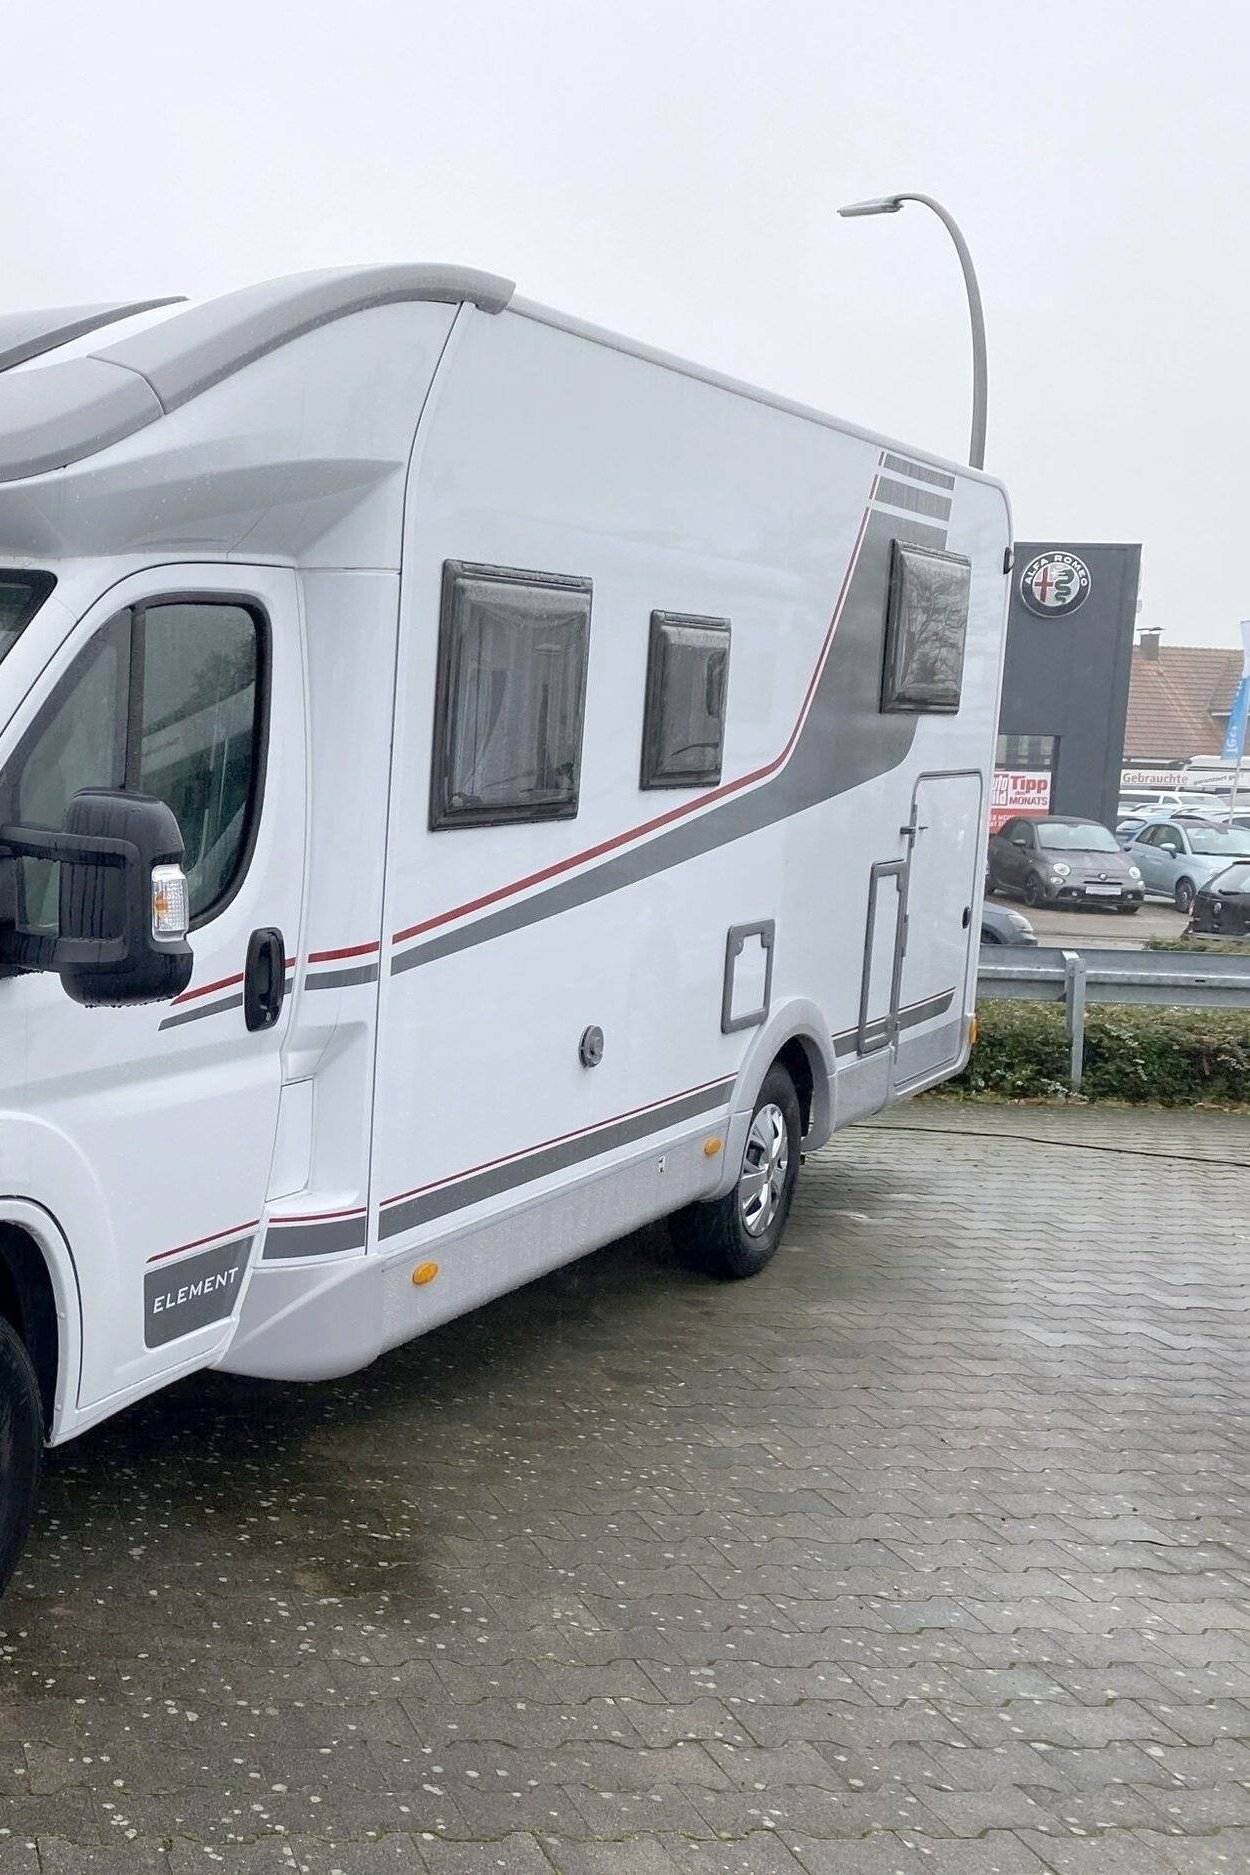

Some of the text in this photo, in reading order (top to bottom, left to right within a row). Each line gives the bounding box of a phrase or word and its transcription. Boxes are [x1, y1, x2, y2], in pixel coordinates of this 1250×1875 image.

[1025, 554, 1088, 586] ALFA ROMEO
[1010, 775, 1048, 794] Tipp
[1122, 771, 1189, 784] Gebrauchte
[1009, 796, 1048, 806] MONATS
[153, 1266, 239, 1314] ELEMENT
